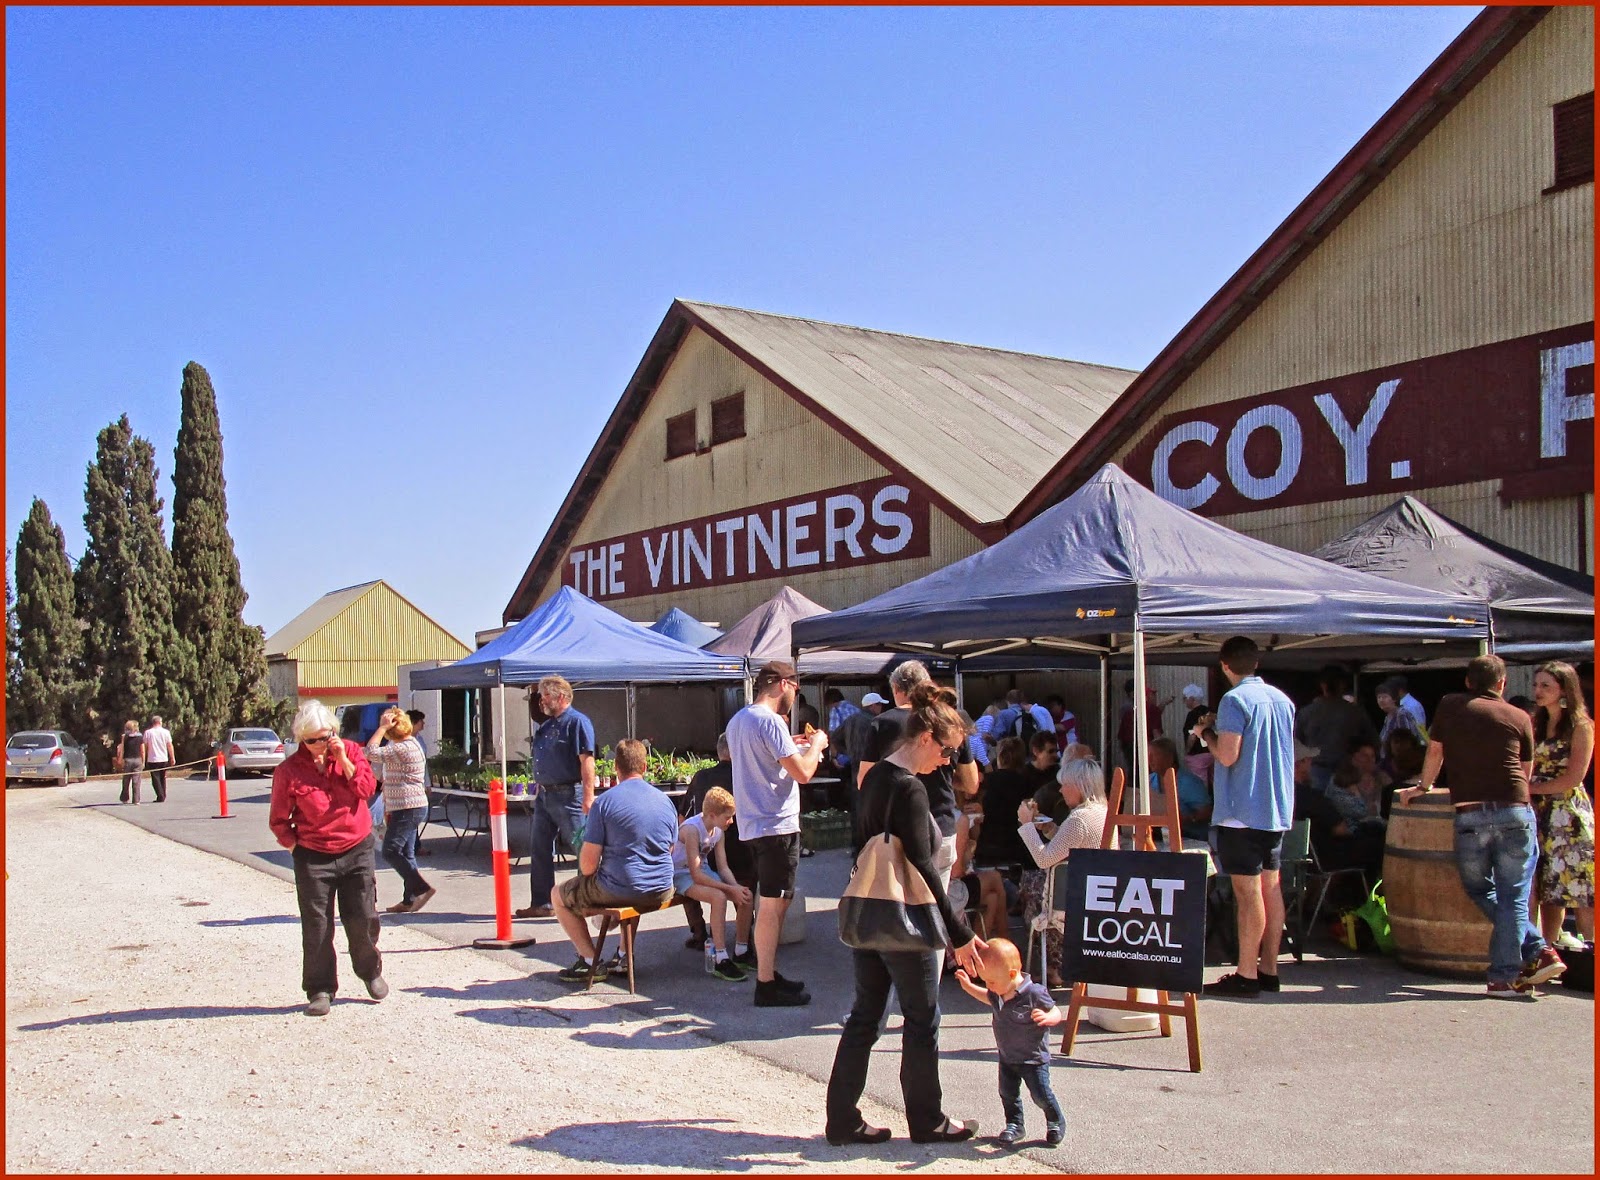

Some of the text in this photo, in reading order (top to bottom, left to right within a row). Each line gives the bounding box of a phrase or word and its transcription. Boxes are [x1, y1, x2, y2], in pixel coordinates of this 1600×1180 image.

[1151, 378, 1411, 509] COY.
[569, 484, 914, 598] THE VINTNERS
[1085, 874, 1185, 916] EAT
[1082, 916, 1183, 949] LOCAL
[1082, 948, 1182, 964] www.eatlocalsa.com.au
